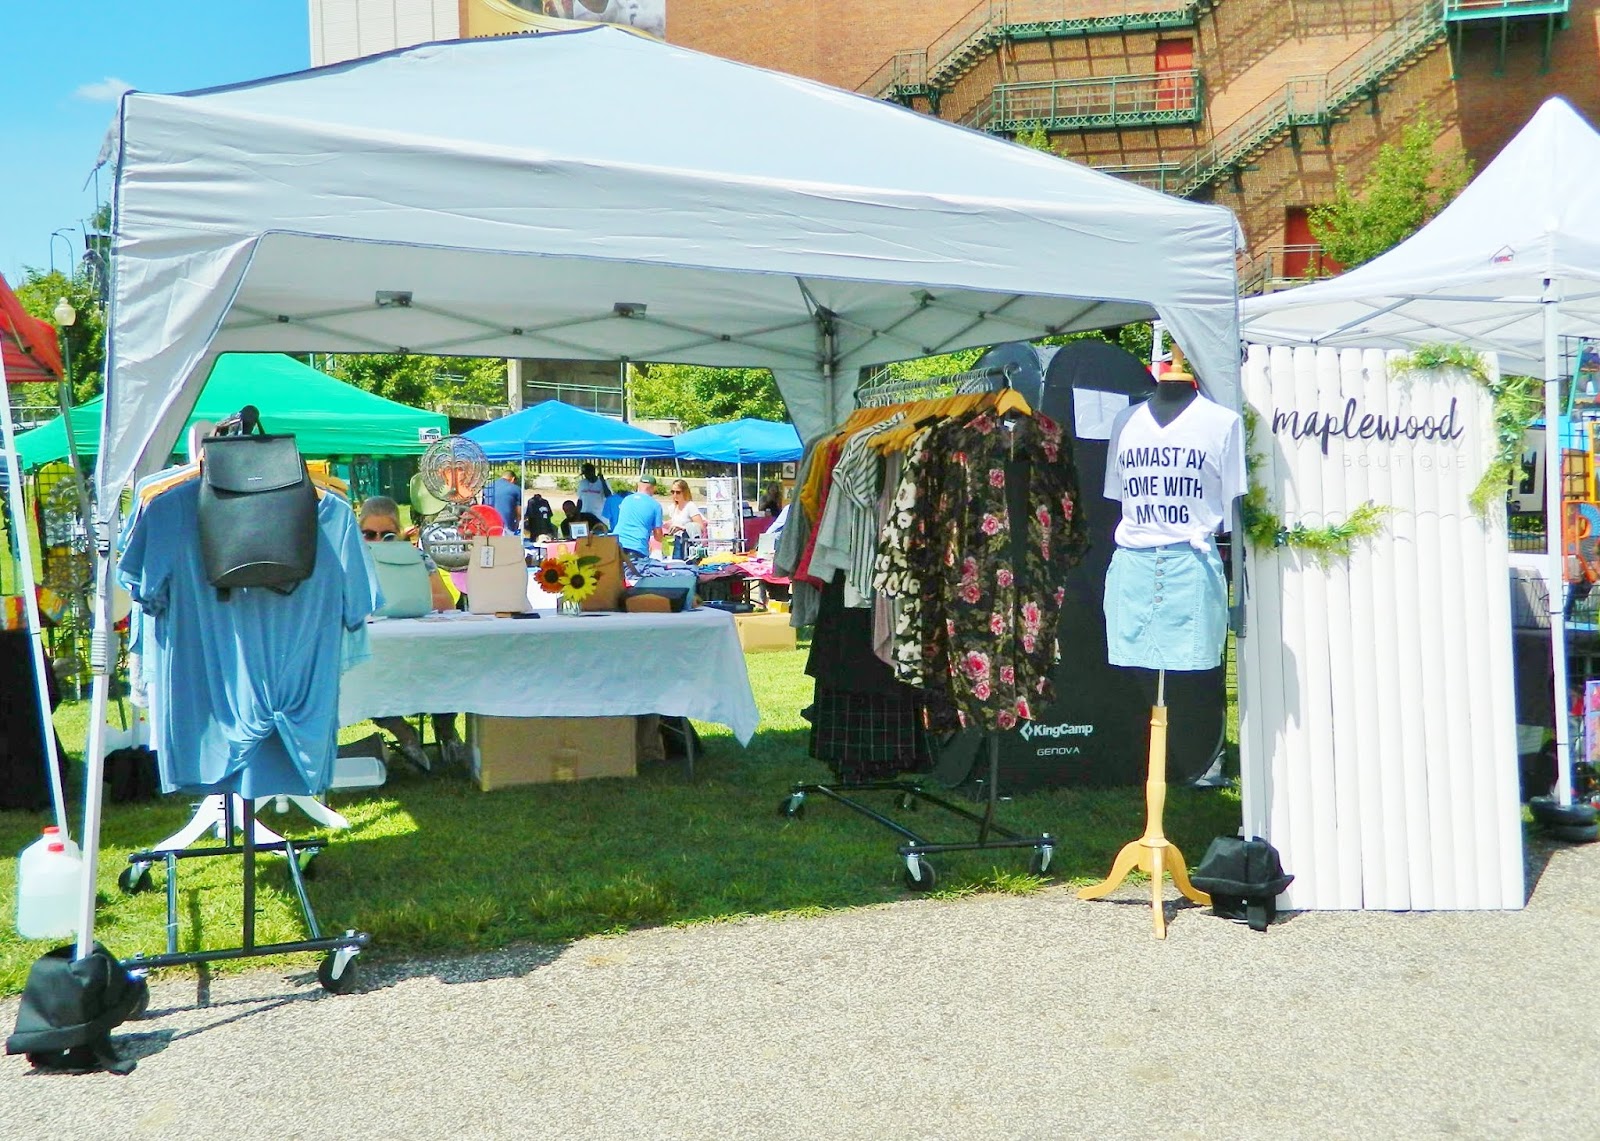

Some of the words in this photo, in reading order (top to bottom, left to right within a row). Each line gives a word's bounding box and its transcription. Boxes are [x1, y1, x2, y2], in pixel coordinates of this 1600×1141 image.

[1272, 397, 1464, 455] maplewood
[1119, 447, 1207, 470] NAMAST'AY
[1123, 476, 1159, 499] HOME
[1164, 476, 1203, 500] WITH
[1033, 723, 1094, 738] KingCamp
[1037, 746, 1080, 757] GENOVA
